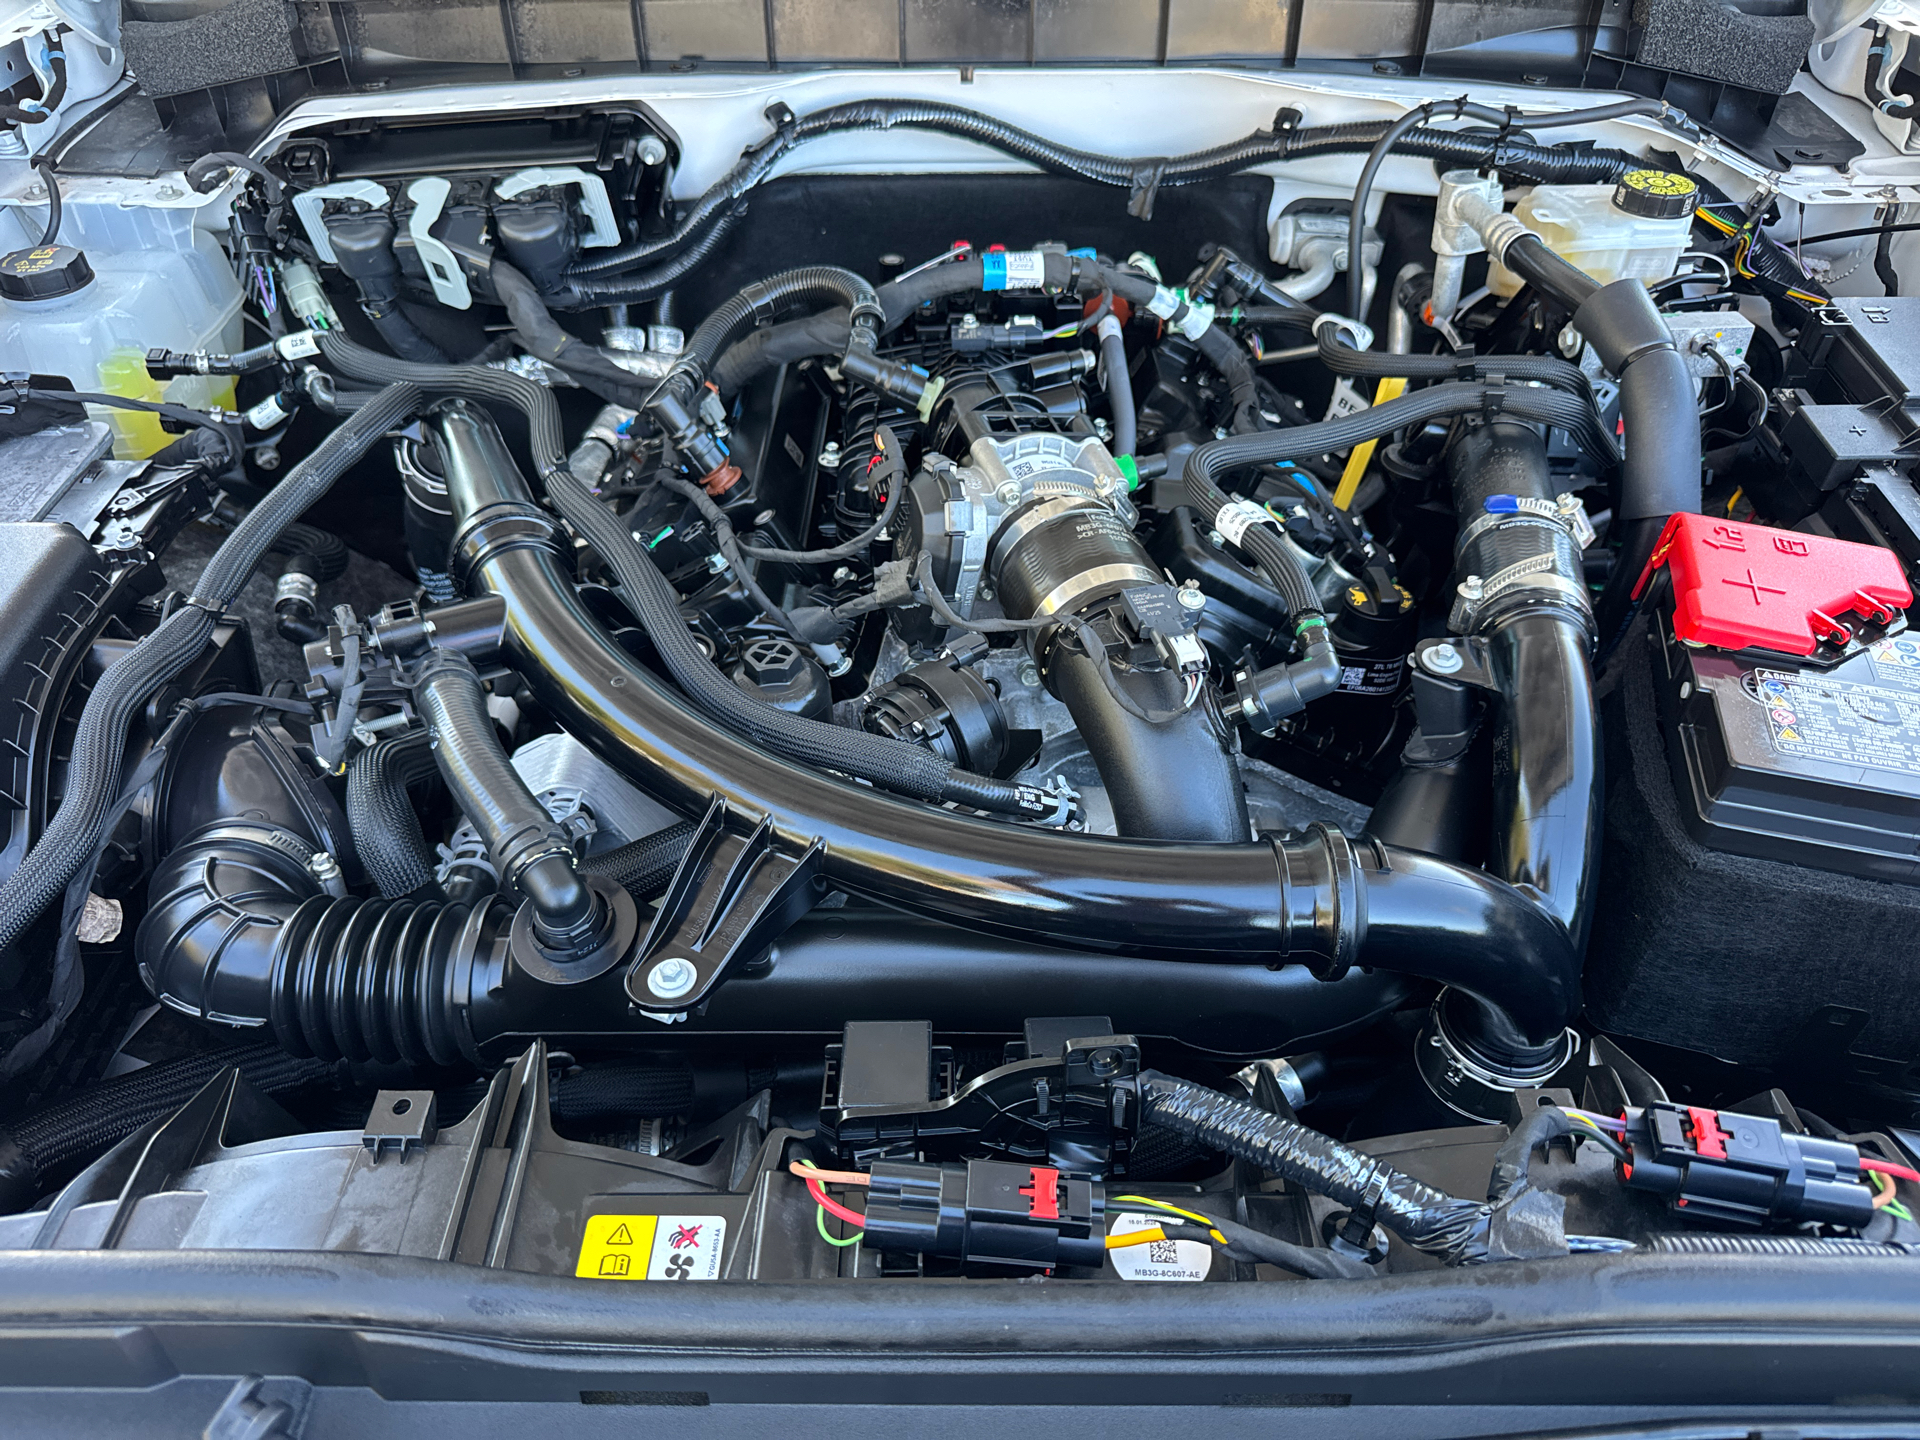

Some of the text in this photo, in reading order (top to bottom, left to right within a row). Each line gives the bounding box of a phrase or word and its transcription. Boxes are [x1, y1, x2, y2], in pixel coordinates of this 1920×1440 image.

[1773, 672, 1842, 690] DANGER/POISON
[1796, 745, 1812, 753] NOT
[1854, 755, 1870, 763] PAS
[1134, 1269, 1201, 1279] MB3G-8C607-AE
